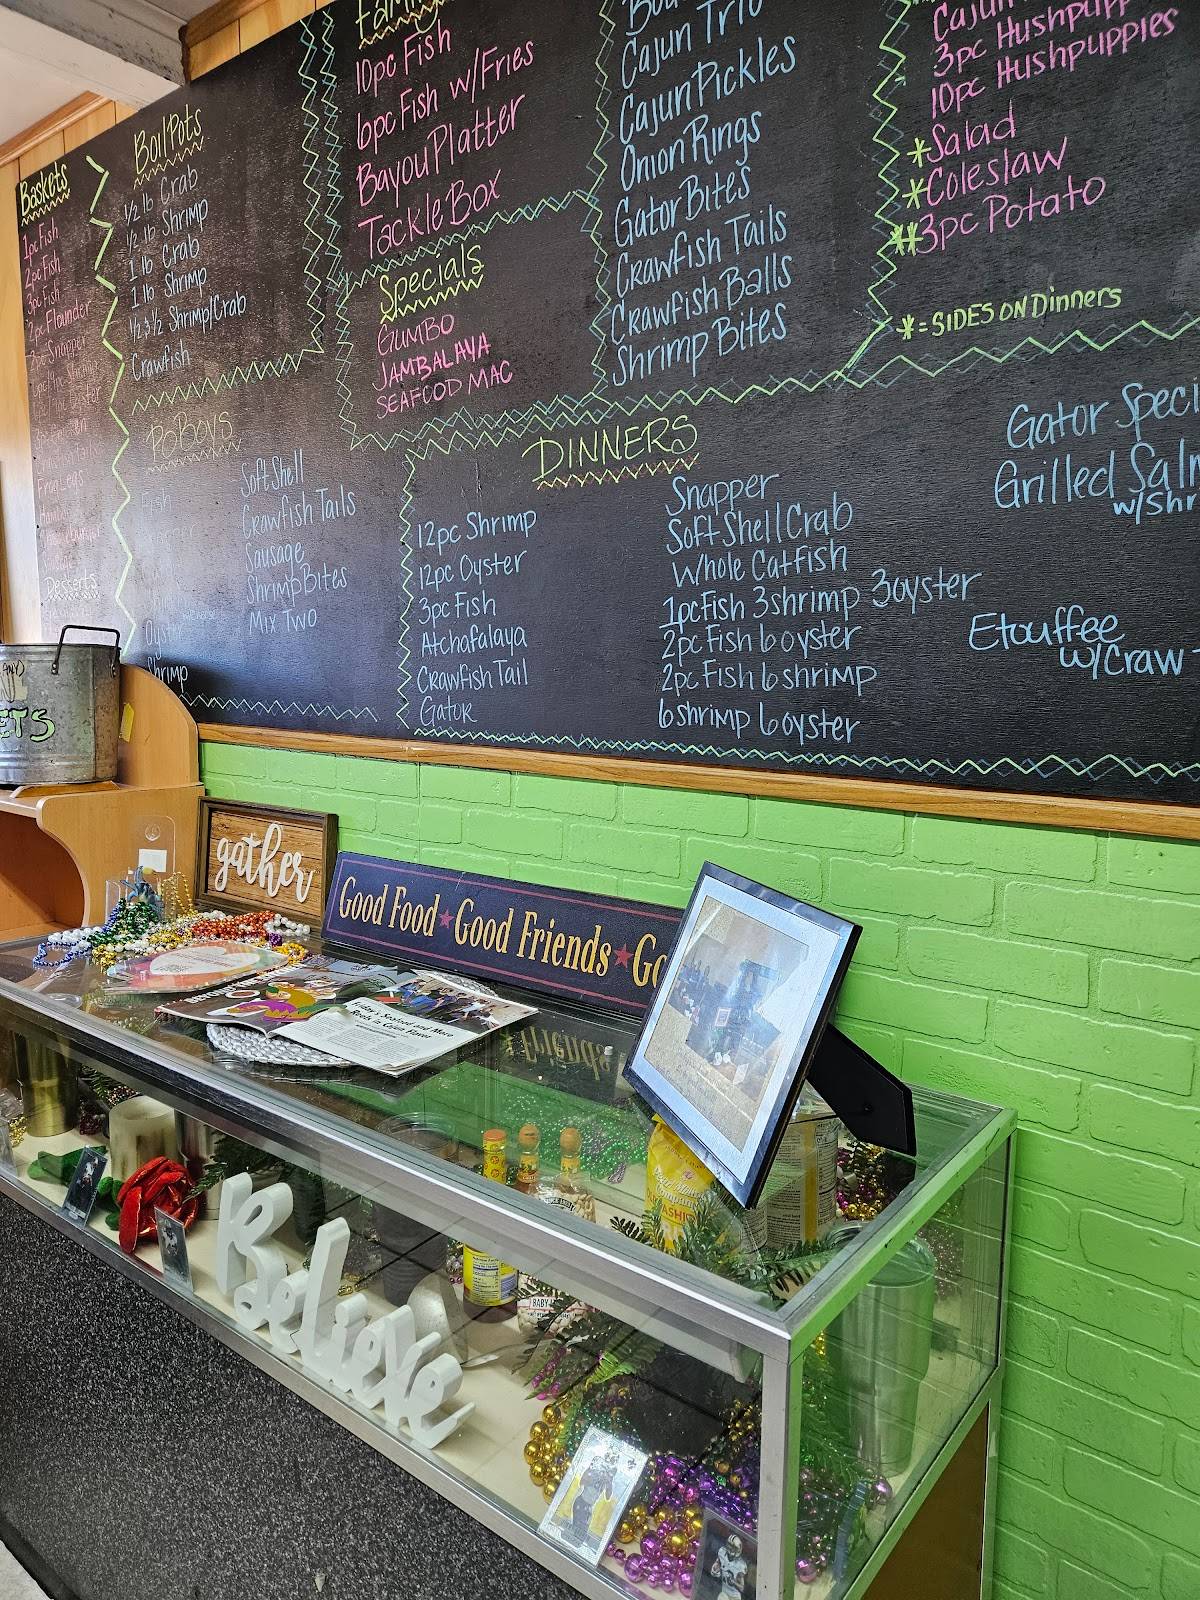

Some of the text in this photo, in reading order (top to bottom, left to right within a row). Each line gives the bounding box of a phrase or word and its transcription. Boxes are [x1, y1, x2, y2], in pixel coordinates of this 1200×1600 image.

[356, 19, 452, 98] 10pc Fish
[621, 22, 692, 89] Cajun
[930, 8, 1179, 119] 10pc Hushpuppies
[933, 39, 987, 78] 3pc
[356, 112, 396, 155] 6pc
[400, 83, 439, 131] Fish
[20, 162, 68, 217] Baskets
[160, 164, 199, 206] Crab
[925, 136, 1068, 207] Coleslaw
[162, 198, 208, 237] Shrimp
[982, 174, 1106, 233] Potato
[161, 234, 200, 270] Crab
[724, 204, 787, 255] Tails
[163, 264, 208, 299] Shrimp
[379, 244, 485, 318] Specials
[719, 252, 793, 311] Balls
[932, 302, 995, 337] SIDES
[1031, 286, 1123, 318] Dinners
[377, 314, 455, 356] GUMBO
[612, 303, 788, 387] Shrimp Bites
[131, 339, 191, 381] Crawfish
[372, 332, 492, 392] JAMBALAYA
[467, 360, 513, 395] MAC
[1006, 401, 1110, 450] Gator
[521, 415, 698, 483] DINNERS
[664, 474, 780, 517] Snapper
[994, 450, 1115, 509] Grilled
[315, 484, 357, 522] Tails
[416, 510, 538, 556] 12pc Shrimp
[665, 515, 721, 555] Soft
[44, 568, 98, 595] Desserts
[245, 542, 305, 583] Sausage
[245, 562, 348, 608] Shrimp Bites
[419, 551, 528, 592] 12pc Oyster
[671, 538, 848, 588] Whole Catfish
[249, 608, 318, 636] Mix Two
[417, 590, 496, 629] 3pc Fish
[968, 604, 1126, 651] Etouffee
[420, 624, 528, 658] Atchafalaya
[661, 629, 702, 667] 2pc
[704, 622, 752, 653] Fish
[147, 656, 189, 693] Shrimp
[493, 659, 529, 687] Tail
[661, 662, 699, 697] 2pc
[701, 658, 755, 690] Fish
[214, 821, 315, 904] gather
[339, 876, 389, 926] Good
[388, 885, 441, 938] Food
[454, 898, 514, 954] Good
[516, 910, 612, 977] Friends
[532, 1298, 549, 1308] BABY
